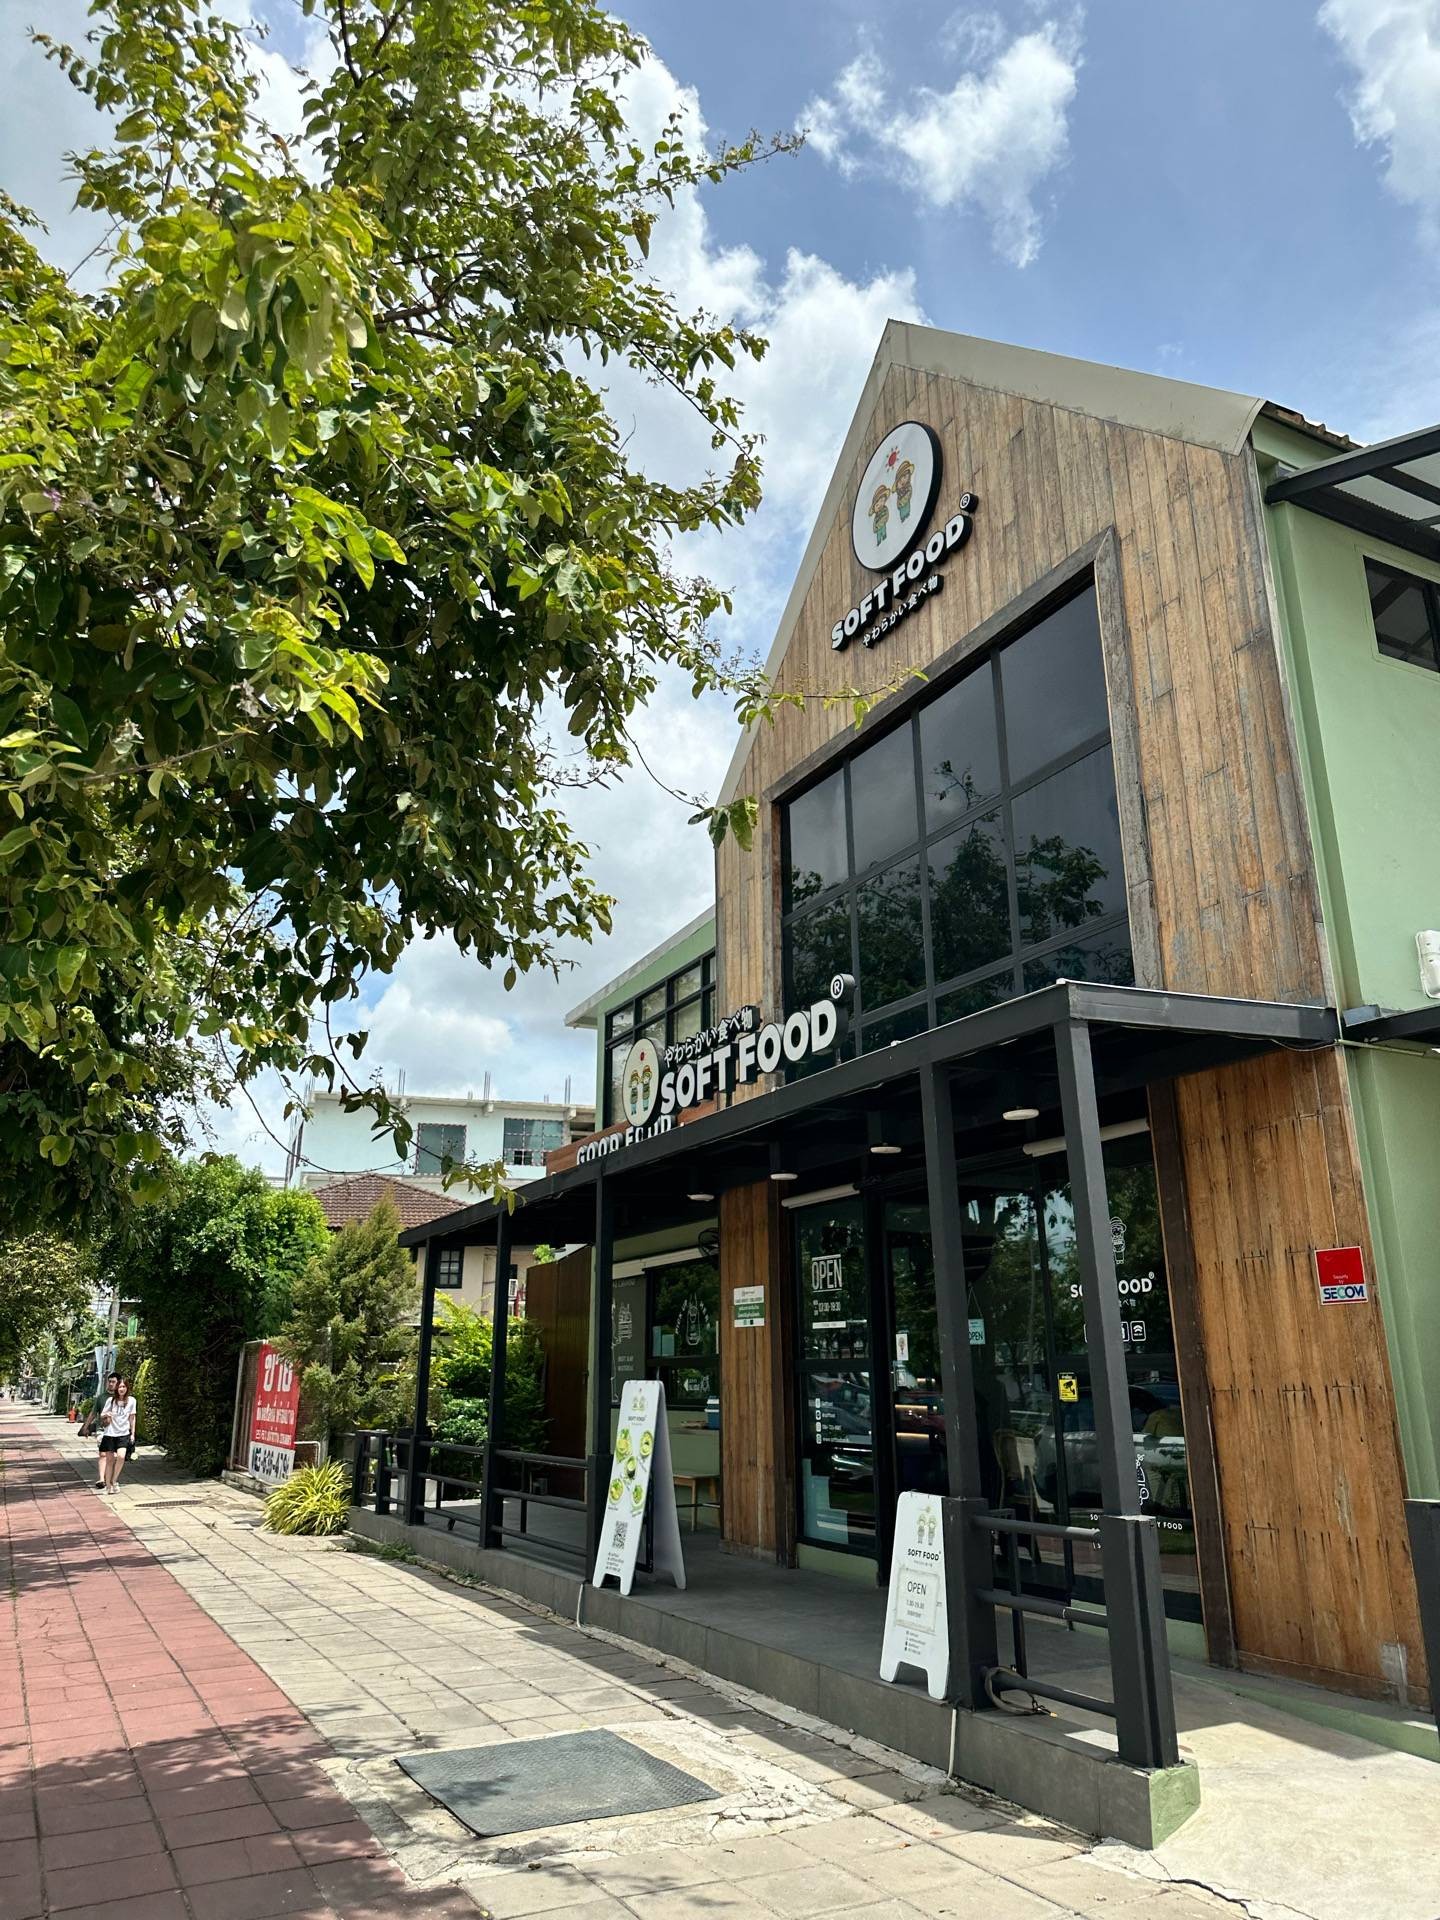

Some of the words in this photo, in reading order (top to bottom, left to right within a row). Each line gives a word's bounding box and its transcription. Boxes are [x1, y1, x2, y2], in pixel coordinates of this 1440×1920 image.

[831, 581, 889, 650] SOFT
[664, 1006, 753, 1068] やわらかい食べ物
[660, 1045, 731, 1115] SOFT
[576, 1133, 619, 1166] GOOD
[811, 1259, 843, 1290] OPEN
[1323, 1285, 1365, 1299] SECOM
[1163, 1522, 1183, 1530] FOOD
[907, 1548, 922, 1558] SOFT
[922, 1552, 940, 1561] FOOD
[907, 1581, 927, 1596] OPEN
